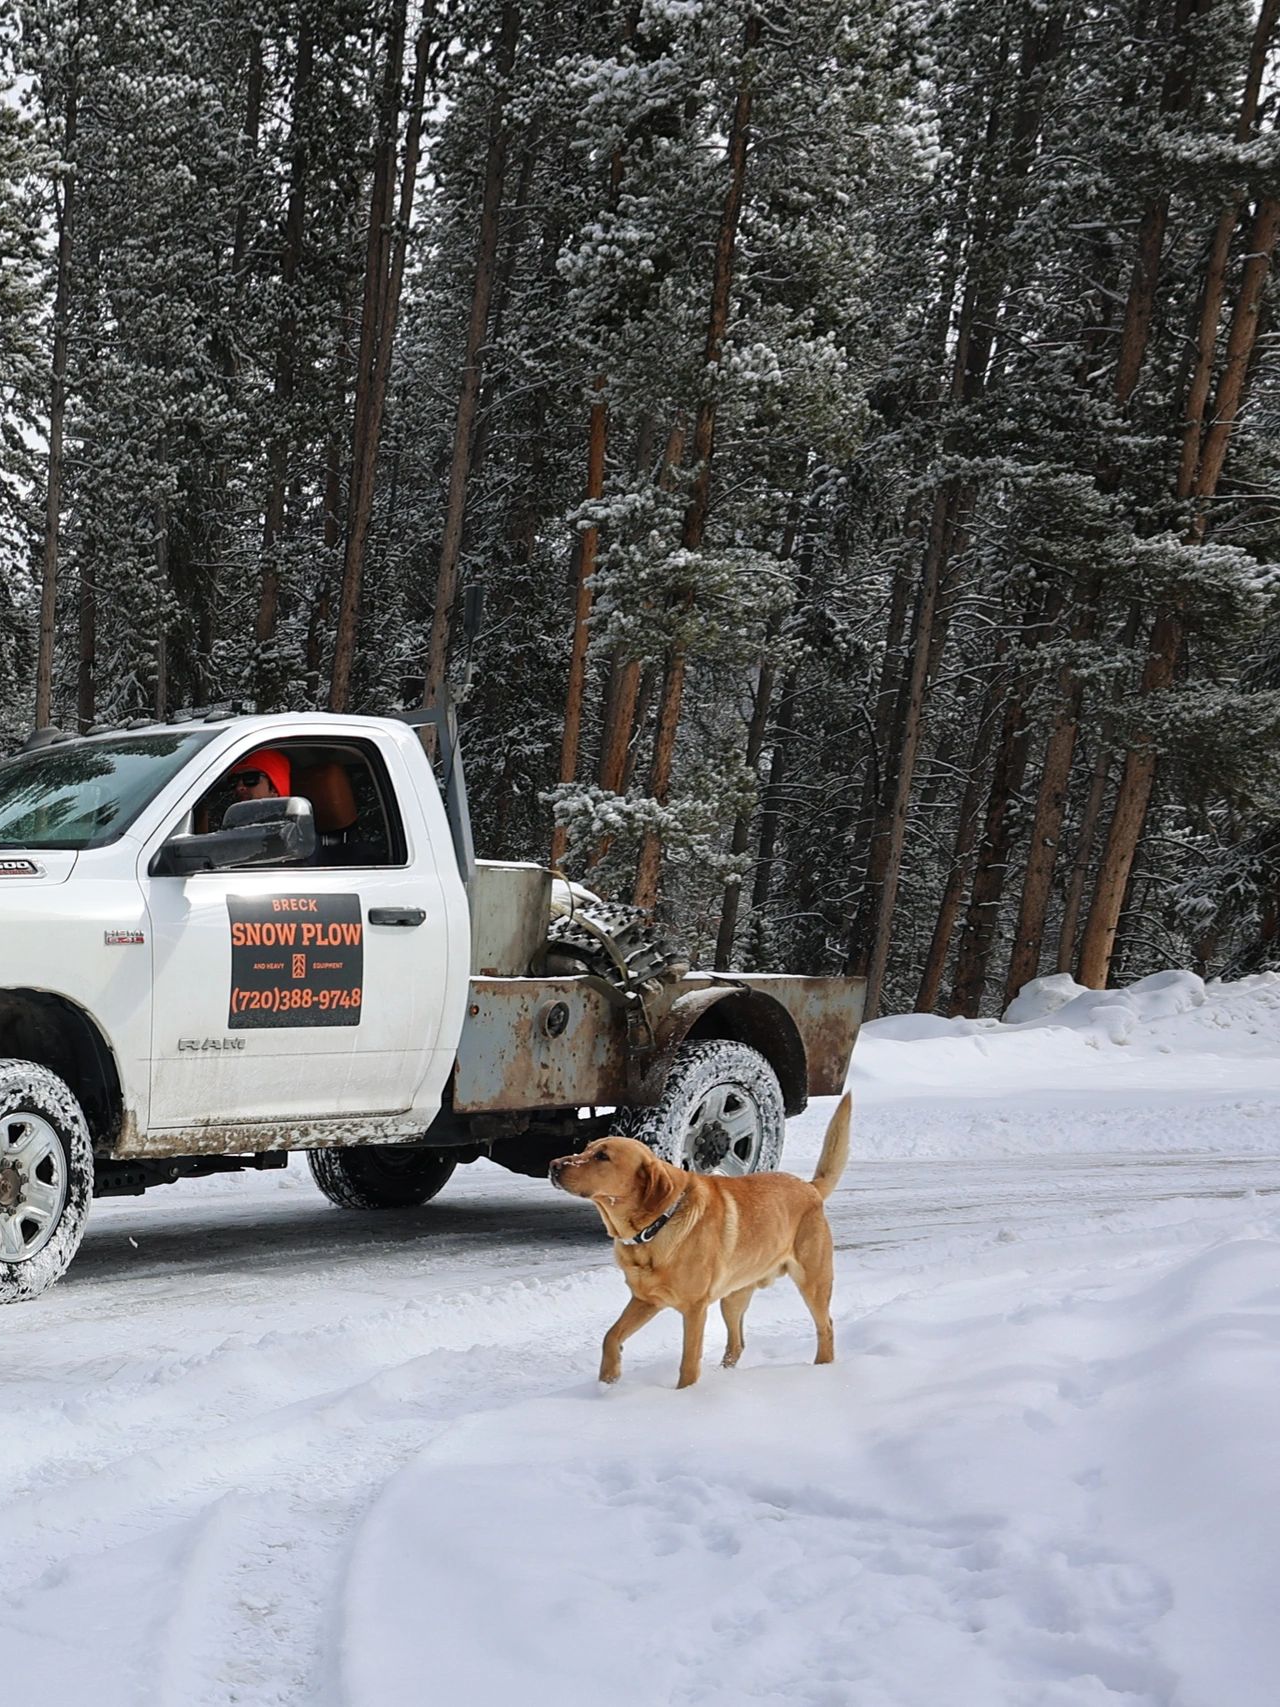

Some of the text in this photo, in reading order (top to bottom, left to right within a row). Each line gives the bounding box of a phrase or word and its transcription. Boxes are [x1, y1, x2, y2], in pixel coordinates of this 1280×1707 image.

[272, 898, 318, 912] BRECK
[232, 922, 362, 946] SNOW PLOW
[231, 987, 361, 1013] (720)388-9748
[178, 1037, 246, 1051] RAM
